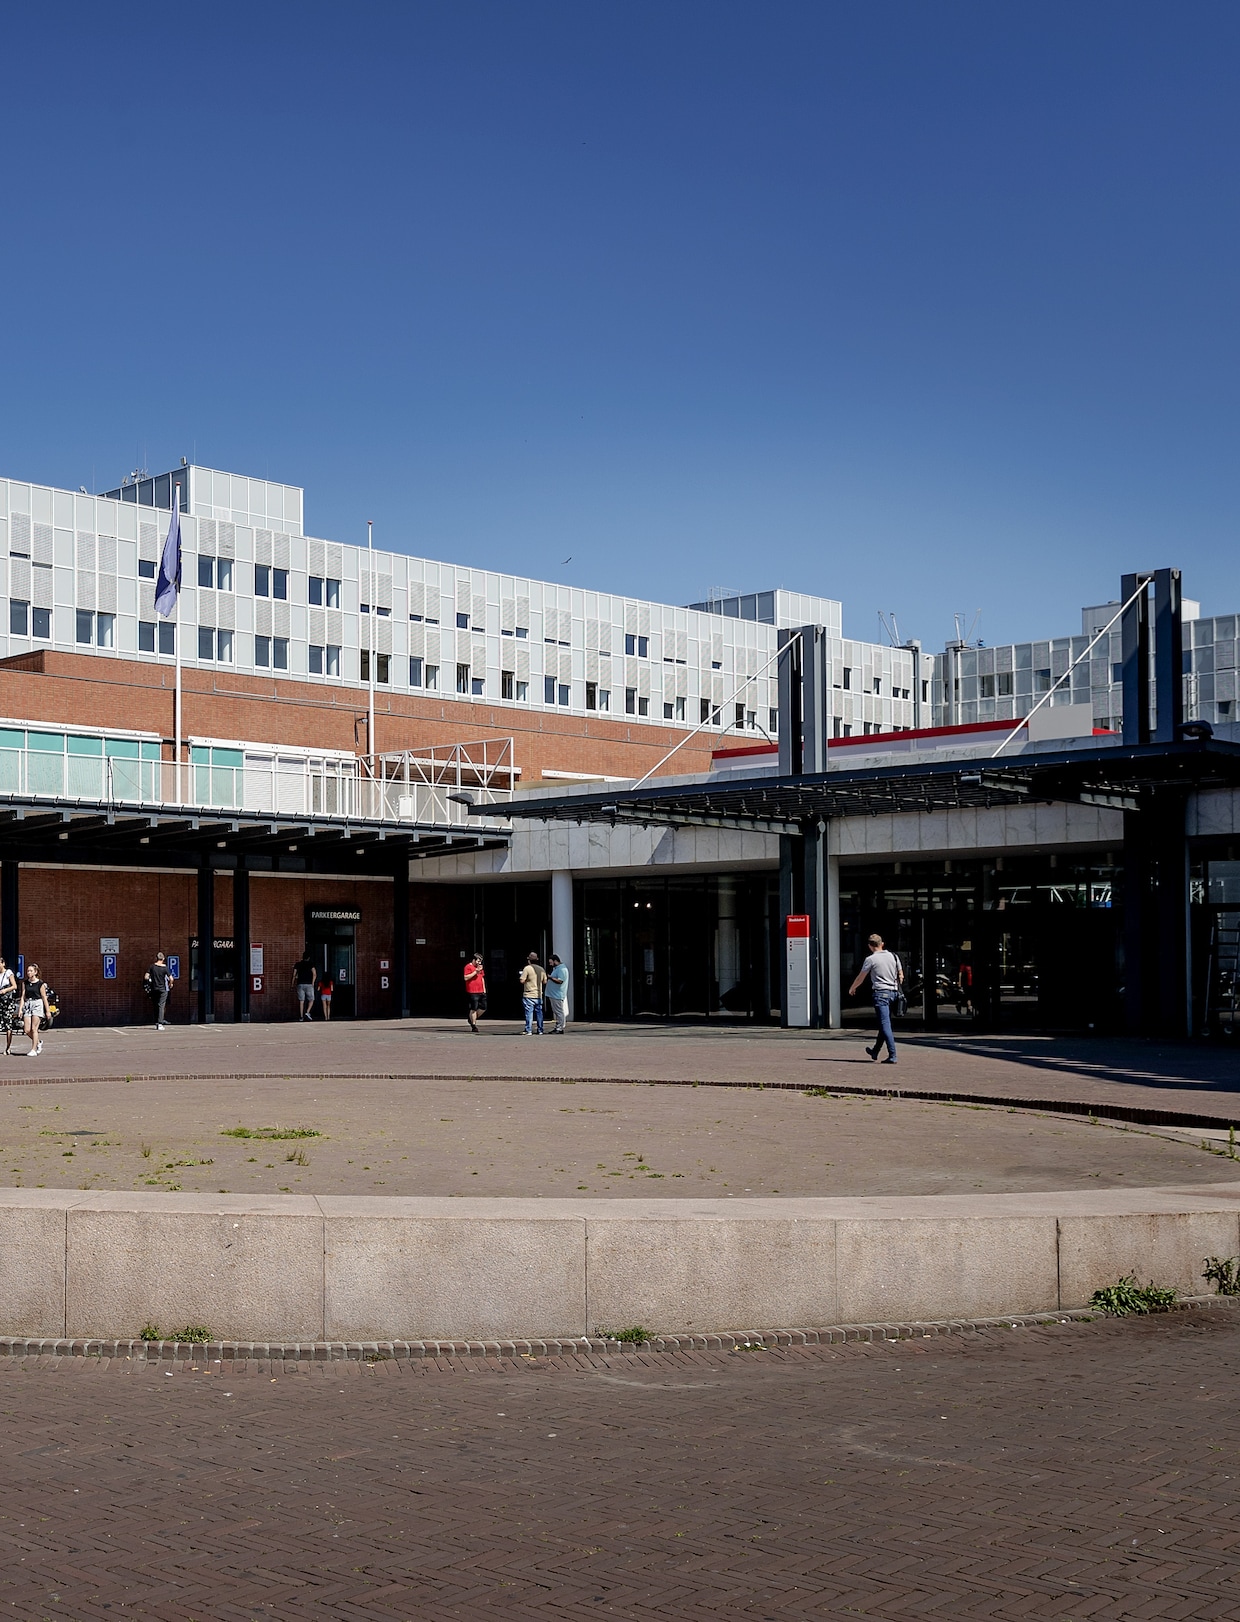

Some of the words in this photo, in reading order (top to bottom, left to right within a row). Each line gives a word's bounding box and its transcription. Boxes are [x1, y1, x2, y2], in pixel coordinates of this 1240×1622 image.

[106, 958, 113, 969] P
[170, 959, 176, 969] P
[253, 977, 262, 991] B
[381, 976, 389, 989] B
